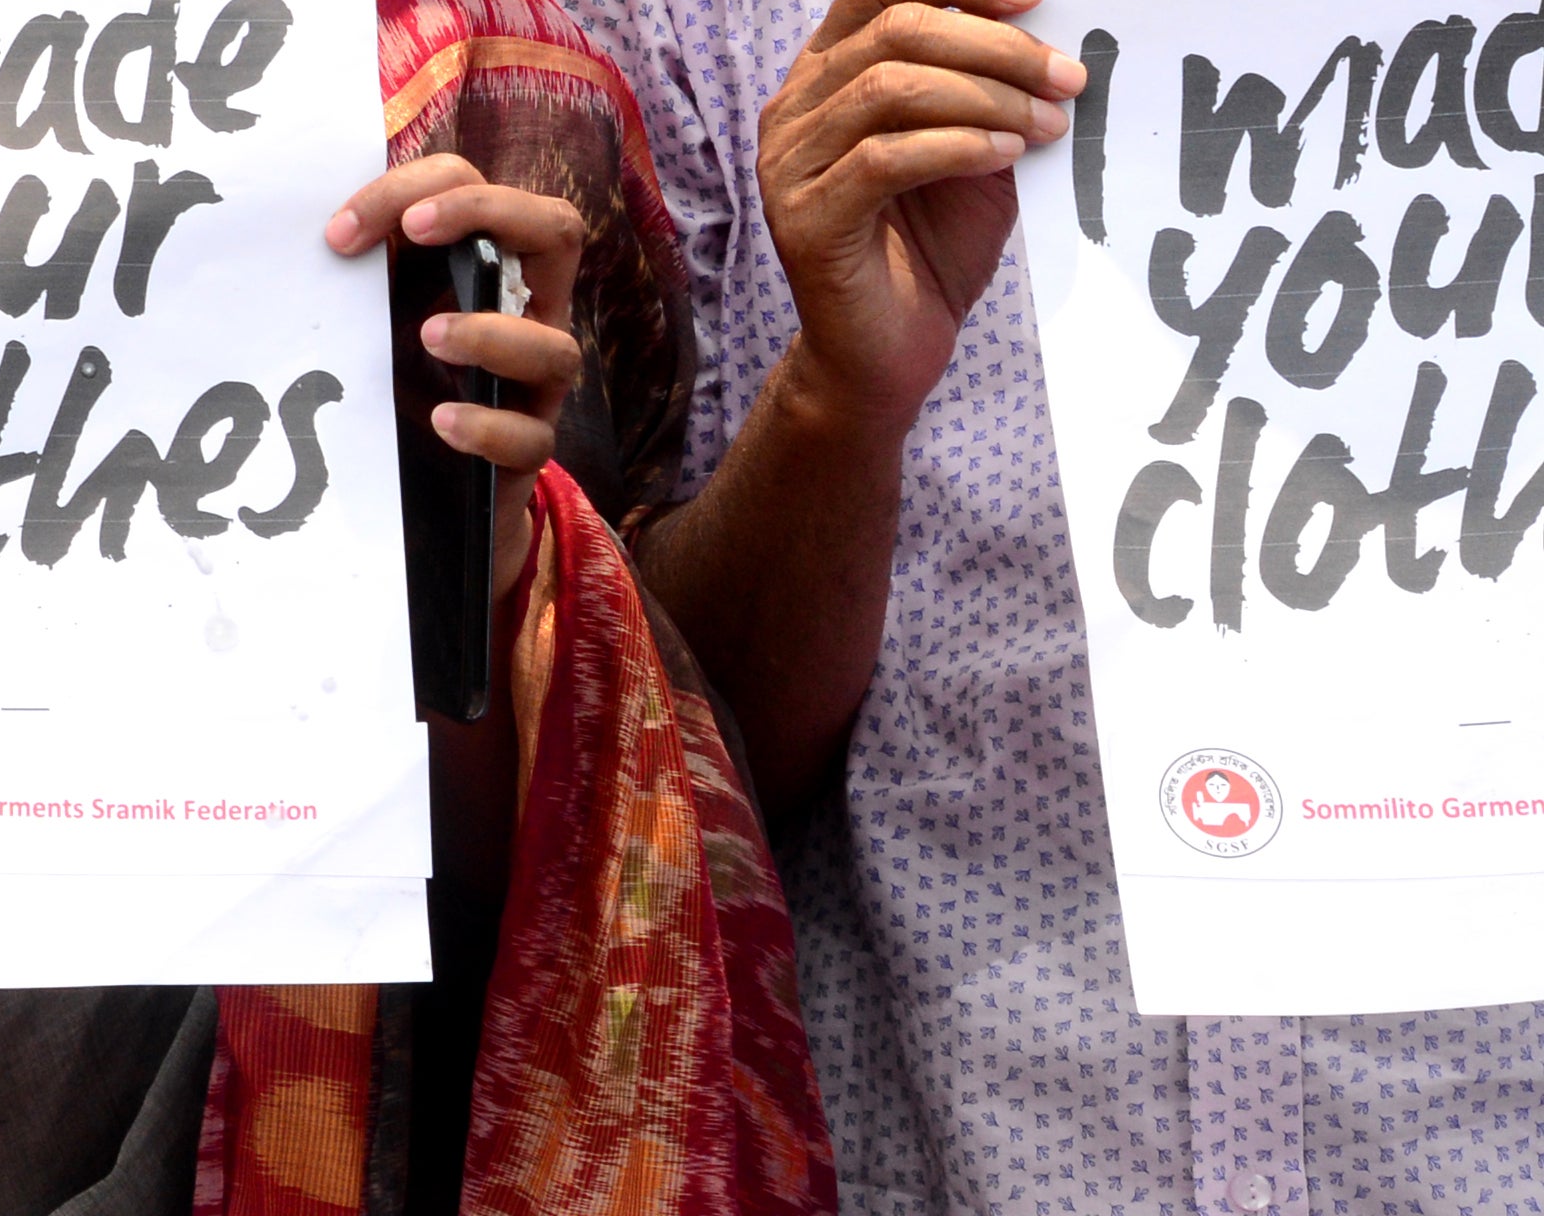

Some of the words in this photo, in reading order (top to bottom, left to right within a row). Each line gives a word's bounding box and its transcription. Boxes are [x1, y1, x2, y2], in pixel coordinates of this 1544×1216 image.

[1072, 28, 1120, 249] I
[1148, 174, 1544, 445] you
[91, 798, 176, 821] Sramik
[1302, 798, 1434, 820] Sommilito
